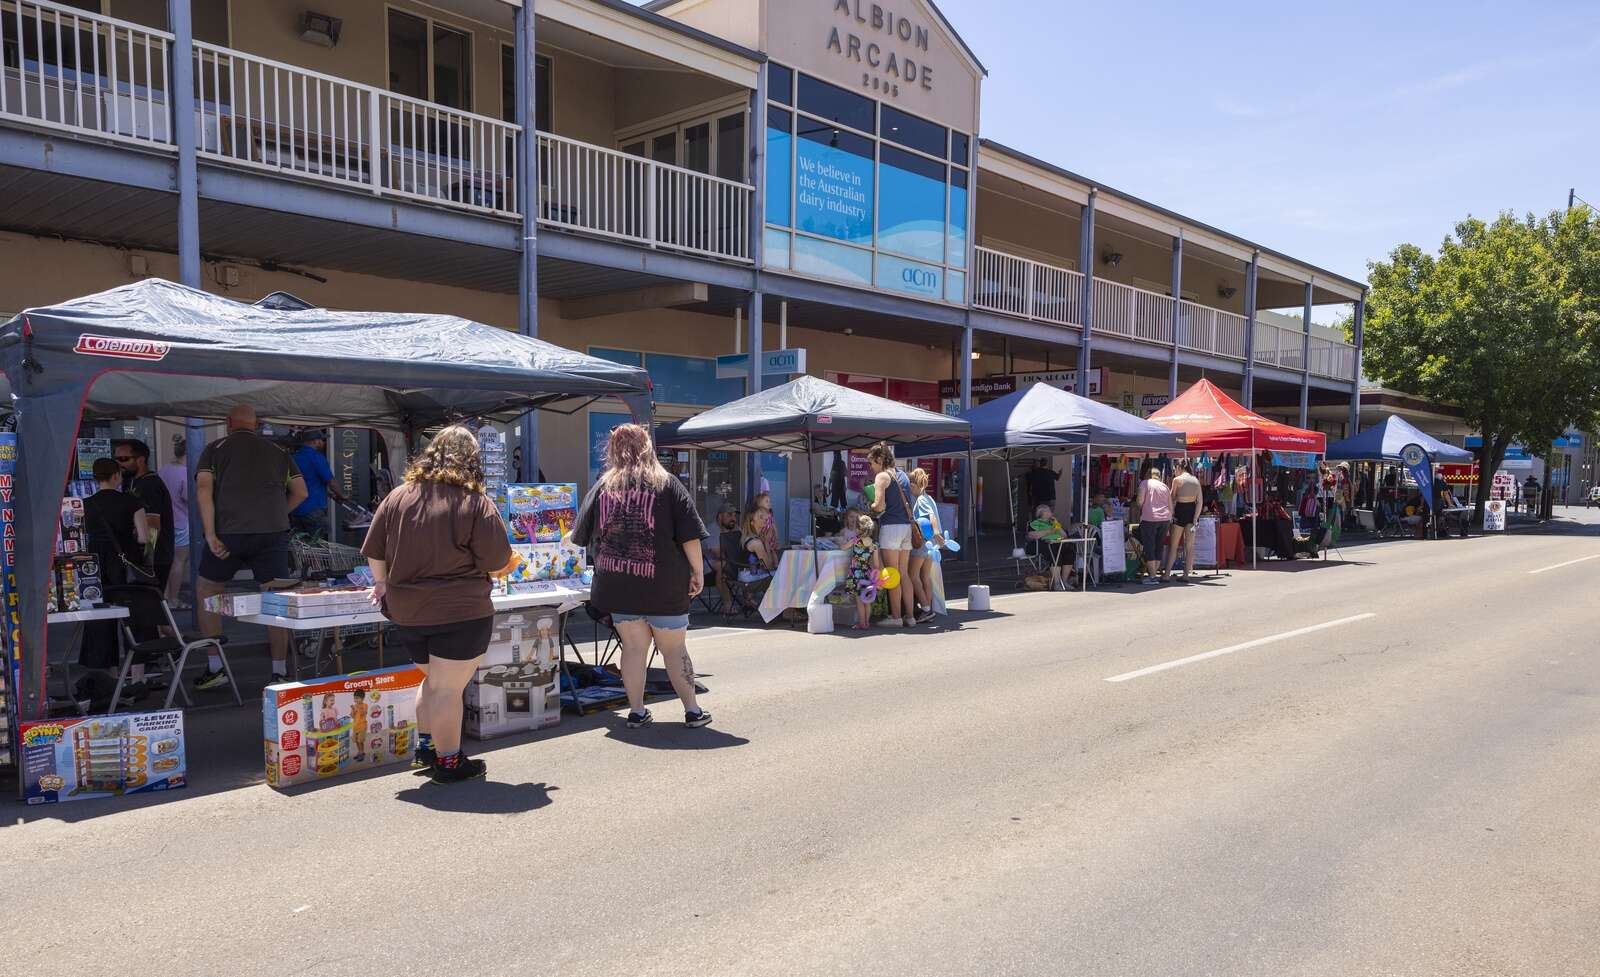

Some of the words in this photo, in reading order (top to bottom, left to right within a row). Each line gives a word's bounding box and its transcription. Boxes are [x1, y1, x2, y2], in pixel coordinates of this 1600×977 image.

[833, 0, 929, 52] ALBION
[826, 26, 933, 91] ARCADE
[799, 155, 815, 173] We
[817, 160, 850, 184] believe
[852, 171, 862, 186] in
[799, 173, 816, 190] the
[817, 178, 865, 203] Australian
[799, 189, 825, 212] dairy
[826, 196, 866, 222] industry
[902, 267, 937, 289] acm
[84, 337, 153, 353] Coleman
[993, 382, 1012, 391] Bank
[0, 474, 13, 503] MY
[2, 508, 16, 567] NAME
[344, 679, 373, 689] Grocery
[375, 675, 395, 685] Store
